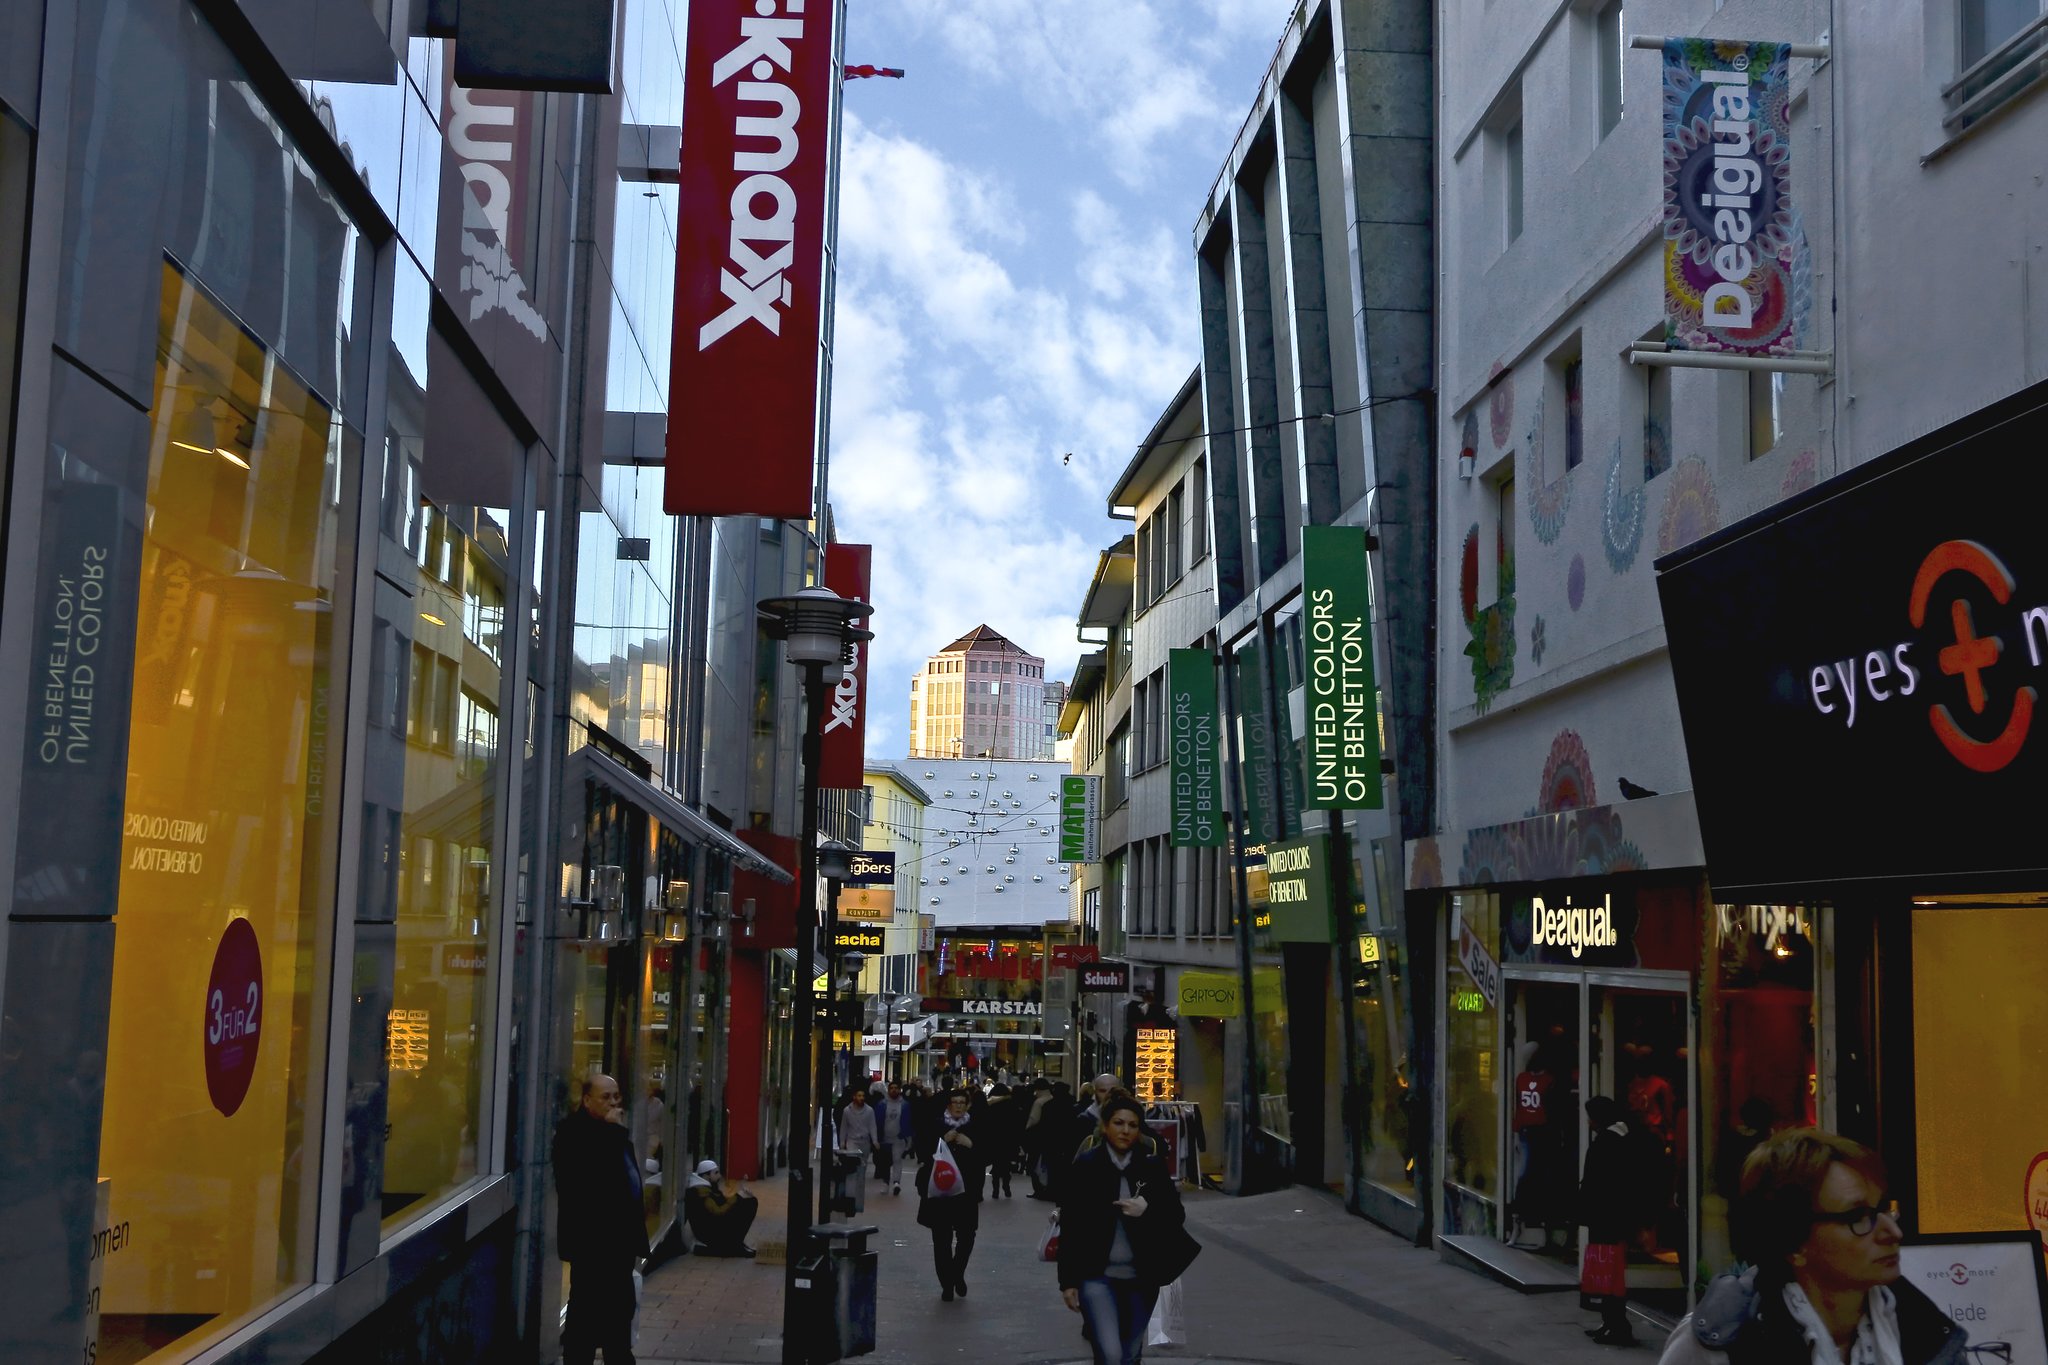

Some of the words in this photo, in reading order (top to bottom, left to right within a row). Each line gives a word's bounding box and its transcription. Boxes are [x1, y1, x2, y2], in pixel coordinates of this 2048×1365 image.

[1701, 69, 1762, 328] Desigual
[1312, 589, 1335, 695] COLORS
[1812, 642, 1920, 728] eyes
[1176, 692, 1191, 767] COLORS
[1315, 703, 1338, 800] UNITED
[1177, 772, 1192, 841] UNITED
[1344, 766, 1366, 801] OF
[1087, 777, 1097, 861] Arbeitnehmerüberlassung
[1197, 816, 1212, 841] OF
[850, 861, 892, 876] gbers
[1267, 851, 1287, 875] UNITED
[1288, 846, 1311, 872] COLORS
[1533, 894, 1611, 958] Desigual
[1084, 972, 1118, 985] Schuh
[1471, 943, 1496, 1000] Sale
[209, 989, 223, 1045] 3
[223, 1006, 244, 1041] FÜR
[245, 981, 258, 1035] 2
[962, 1000, 1042, 1015] KARSTA
[1521, 1090, 1541, 1108] 50
